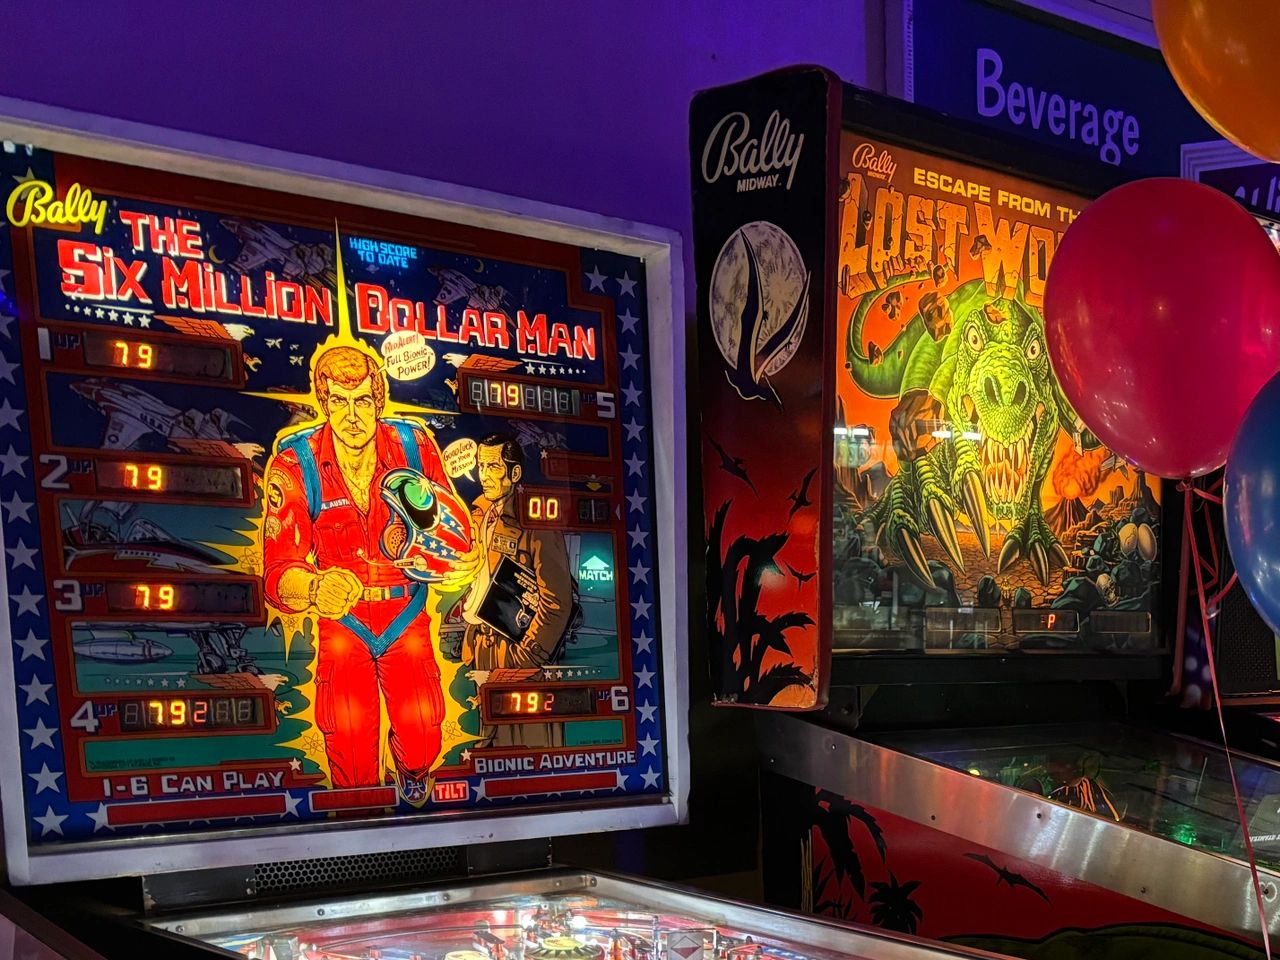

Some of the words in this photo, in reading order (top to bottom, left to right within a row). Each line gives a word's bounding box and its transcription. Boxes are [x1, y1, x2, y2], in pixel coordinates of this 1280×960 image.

[977, 48, 1140, 166] Beverage
[702, 110, 804, 190] Bally
[852, 143, 897, 182] Bally
[736, 174, 780, 192] MIDWAY
[914, 167, 991, 202] ESCAPE
[998, 189, 1051, 218] FROM
[1056, 205, 1081, 223] TH
[6, 180, 107, 234] Bally
[119, 210, 204, 259] THE
[349, 237, 379, 253] HIGH
[380, 242, 418, 260] SCORE
[838, 172, 969, 300] LOST
[357, 251, 376, 263] TO
[378, 253, 409, 268] DATE
[354, 282, 510, 350] DOLLAR
[516, 310, 596, 361] MAN
[37, 327, 51, 360] 1
[115, 342, 152, 368] 79
[596, 392, 616, 418] 5
[40, 454, 70, 489] 2
[125, 465, 163, 490] 79
[579, 570, 614, 581] MATCH
[53, 580, 82, 610] 3
[136, 586, 174, 609] 79
[611, 685, 629, 711] 6
[70, 701, 99, 732] 4
[475, 757, 534, 774] BIONIC
[539, 751, 636, 769] ADVENTURE
[103, 776, 148, 797] 1-6
[161, 775, 213, 793] CAN
[222, 771, 284, 790] PLAY
[435, 783, 467, 800] TILT
